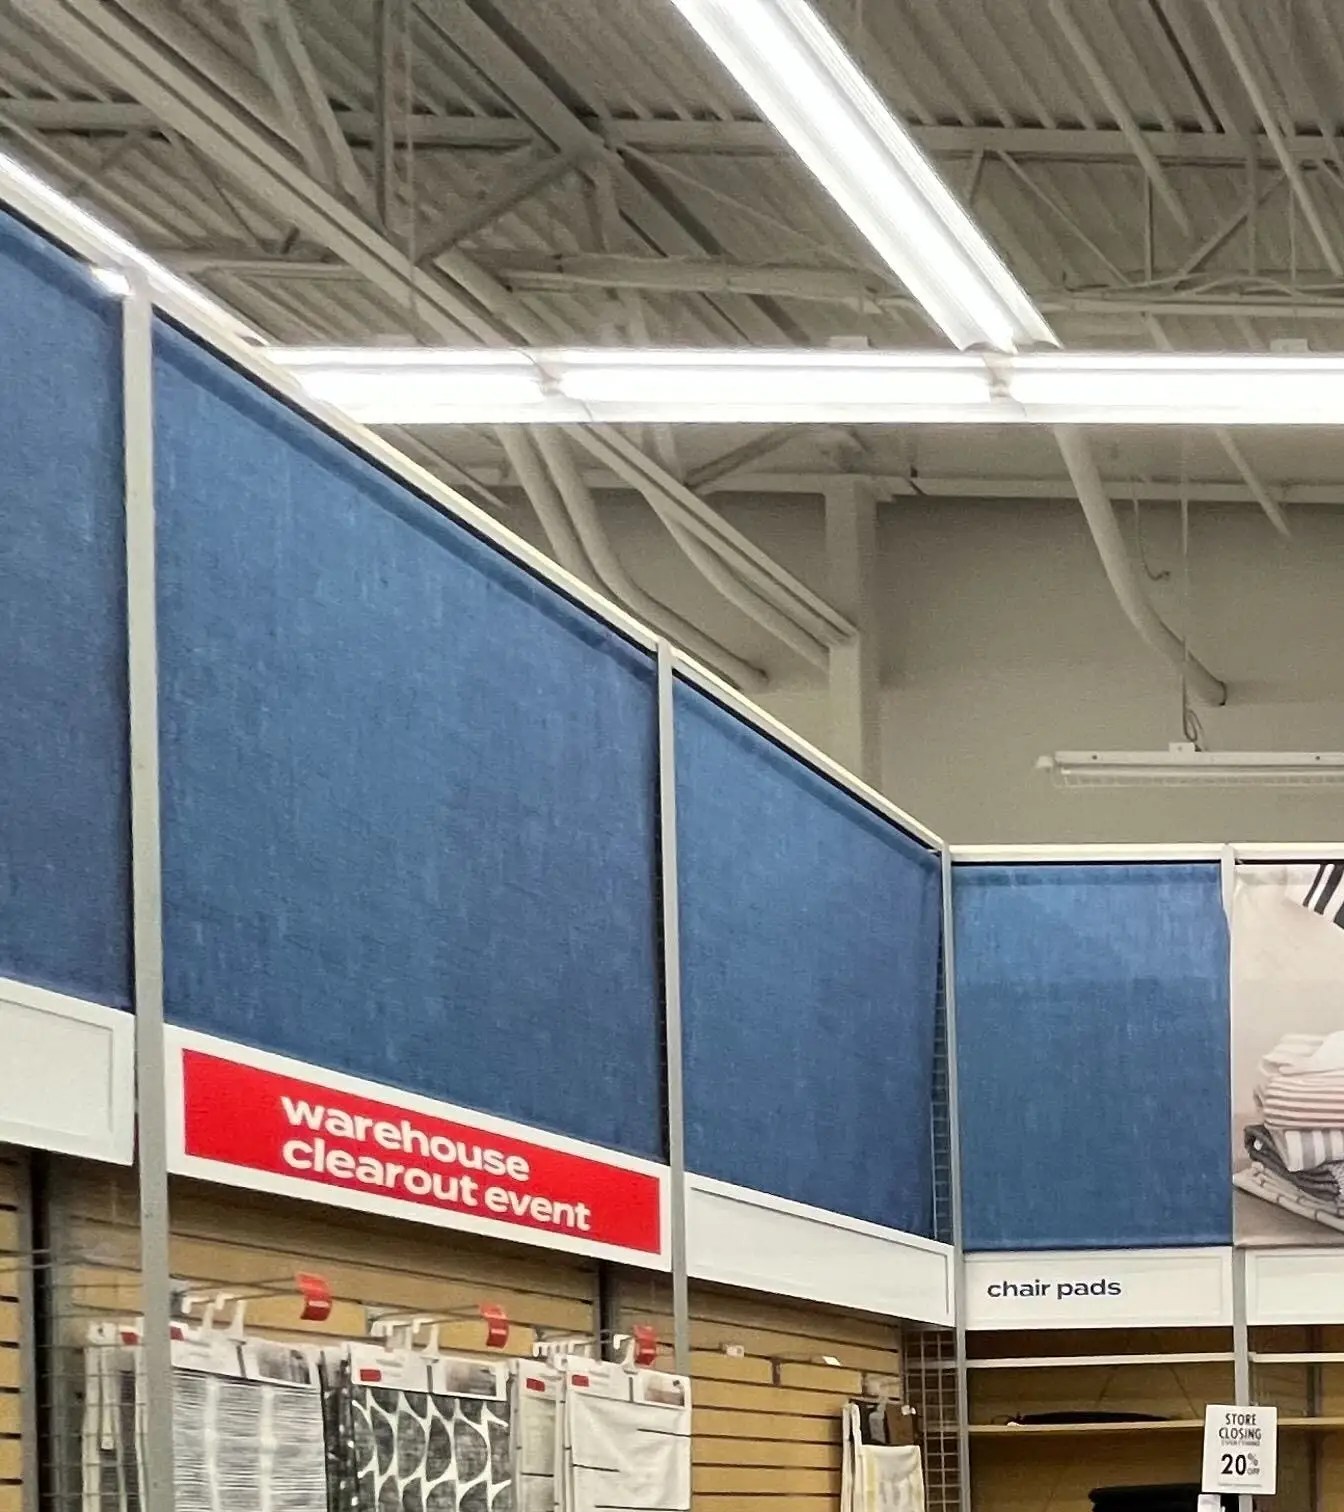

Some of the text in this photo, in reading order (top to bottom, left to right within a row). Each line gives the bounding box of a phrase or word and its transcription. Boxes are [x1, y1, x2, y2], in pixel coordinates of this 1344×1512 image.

[281, 1096, 529, 1182] warehouse
[282, 1138, 591, 1231] clearout event
[987, 1278, 1122, 1300] chair pads
[1225, 1413, 1256, 1425] STORE
[1219, 1427, 1262, 1440] CLOSING
